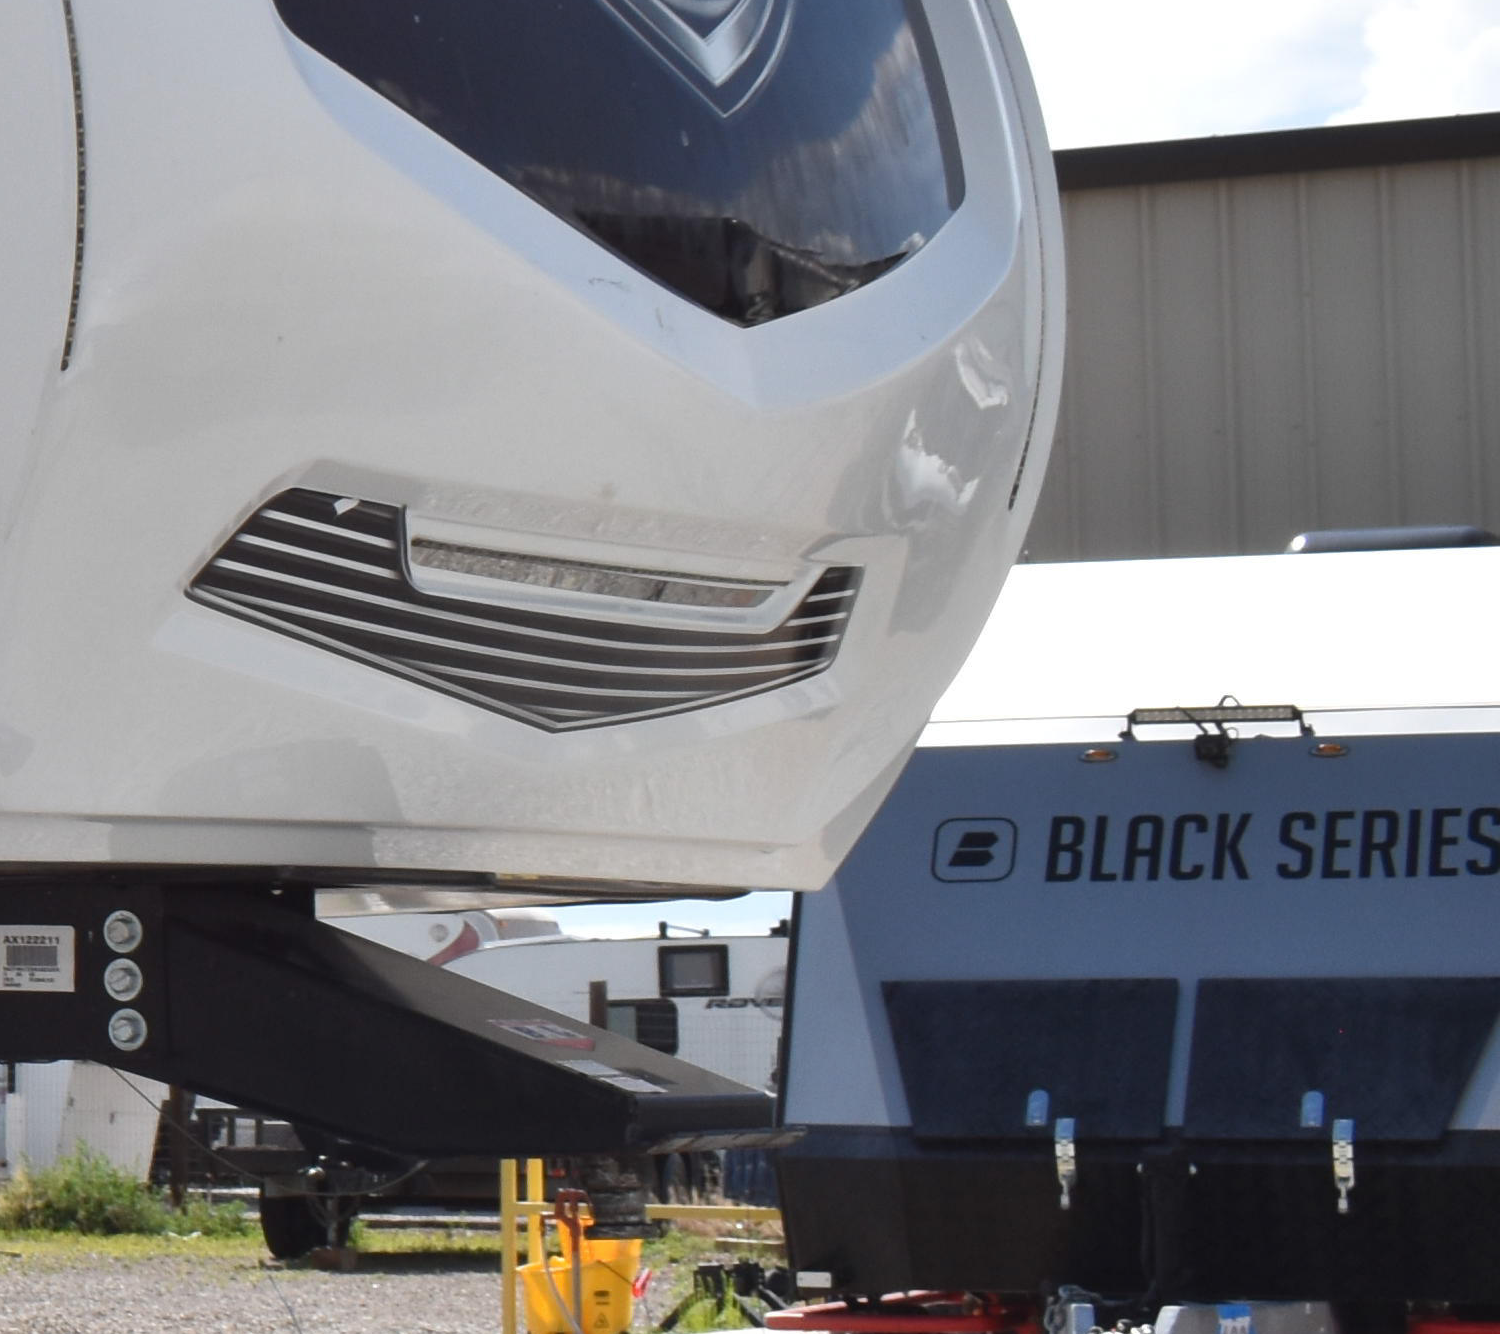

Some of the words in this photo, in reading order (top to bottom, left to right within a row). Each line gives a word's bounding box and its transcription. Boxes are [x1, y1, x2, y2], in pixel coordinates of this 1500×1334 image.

[1045, 812, 1253, 882] BLACK
[1276, 807, 1500, 879] SERIES
[3, 935, 60, 944] AX122211
